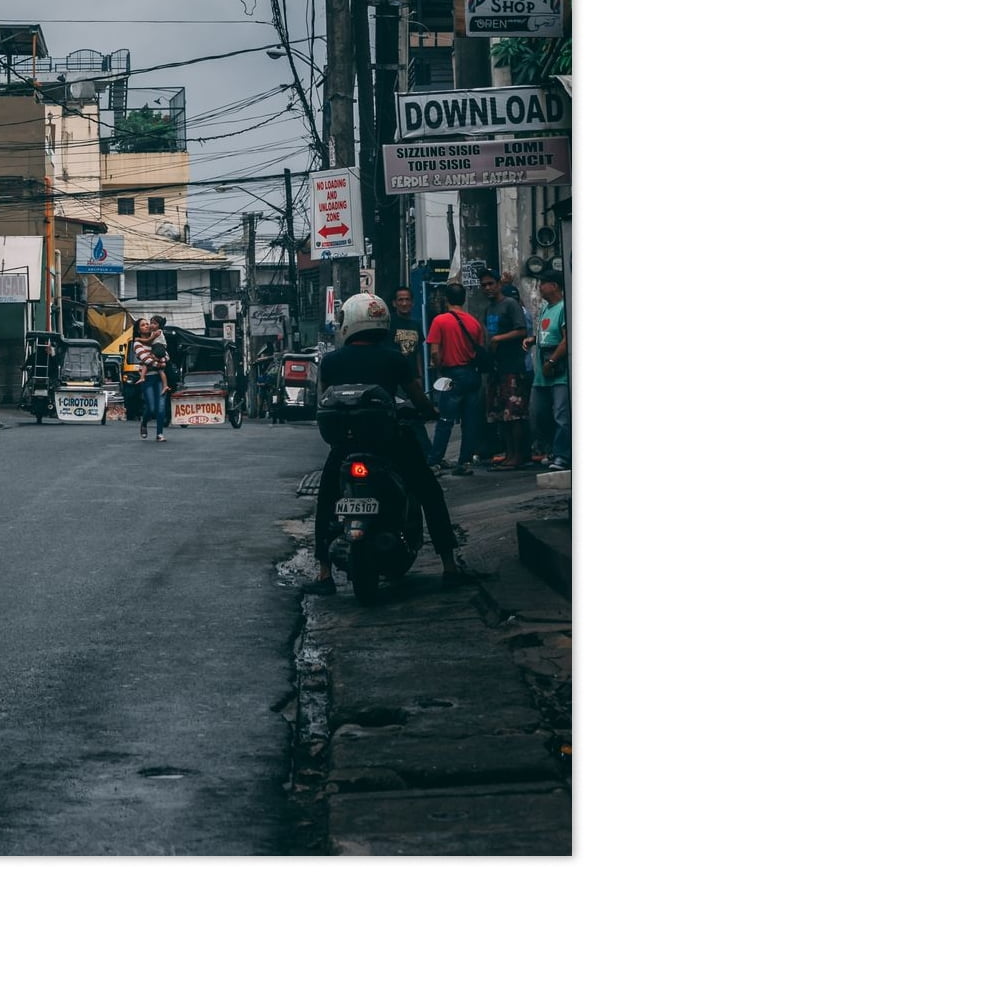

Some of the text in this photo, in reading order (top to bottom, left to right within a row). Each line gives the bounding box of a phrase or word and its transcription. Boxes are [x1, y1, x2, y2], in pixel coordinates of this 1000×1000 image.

[475, 19, 508, 29] OPEN
[404, 93, 564, 131] DOWNLOAD
[397, 144, 480, 159] SIZZLING SISIG
[504, 141, 544, 154] LOMI
[408, 158, 471, 172] TOFU SISIG
[495, 153, 554, 168] PANCIT
[316, 179, 347, 190] NO LOADING
[391, 170, 524, 188] FERDIE & ANNE EATERY
[327, 191, 337, 200] AND
[319, 200, 348, 212] UNLOADING
[326, 212, 340, 222] ZONE
